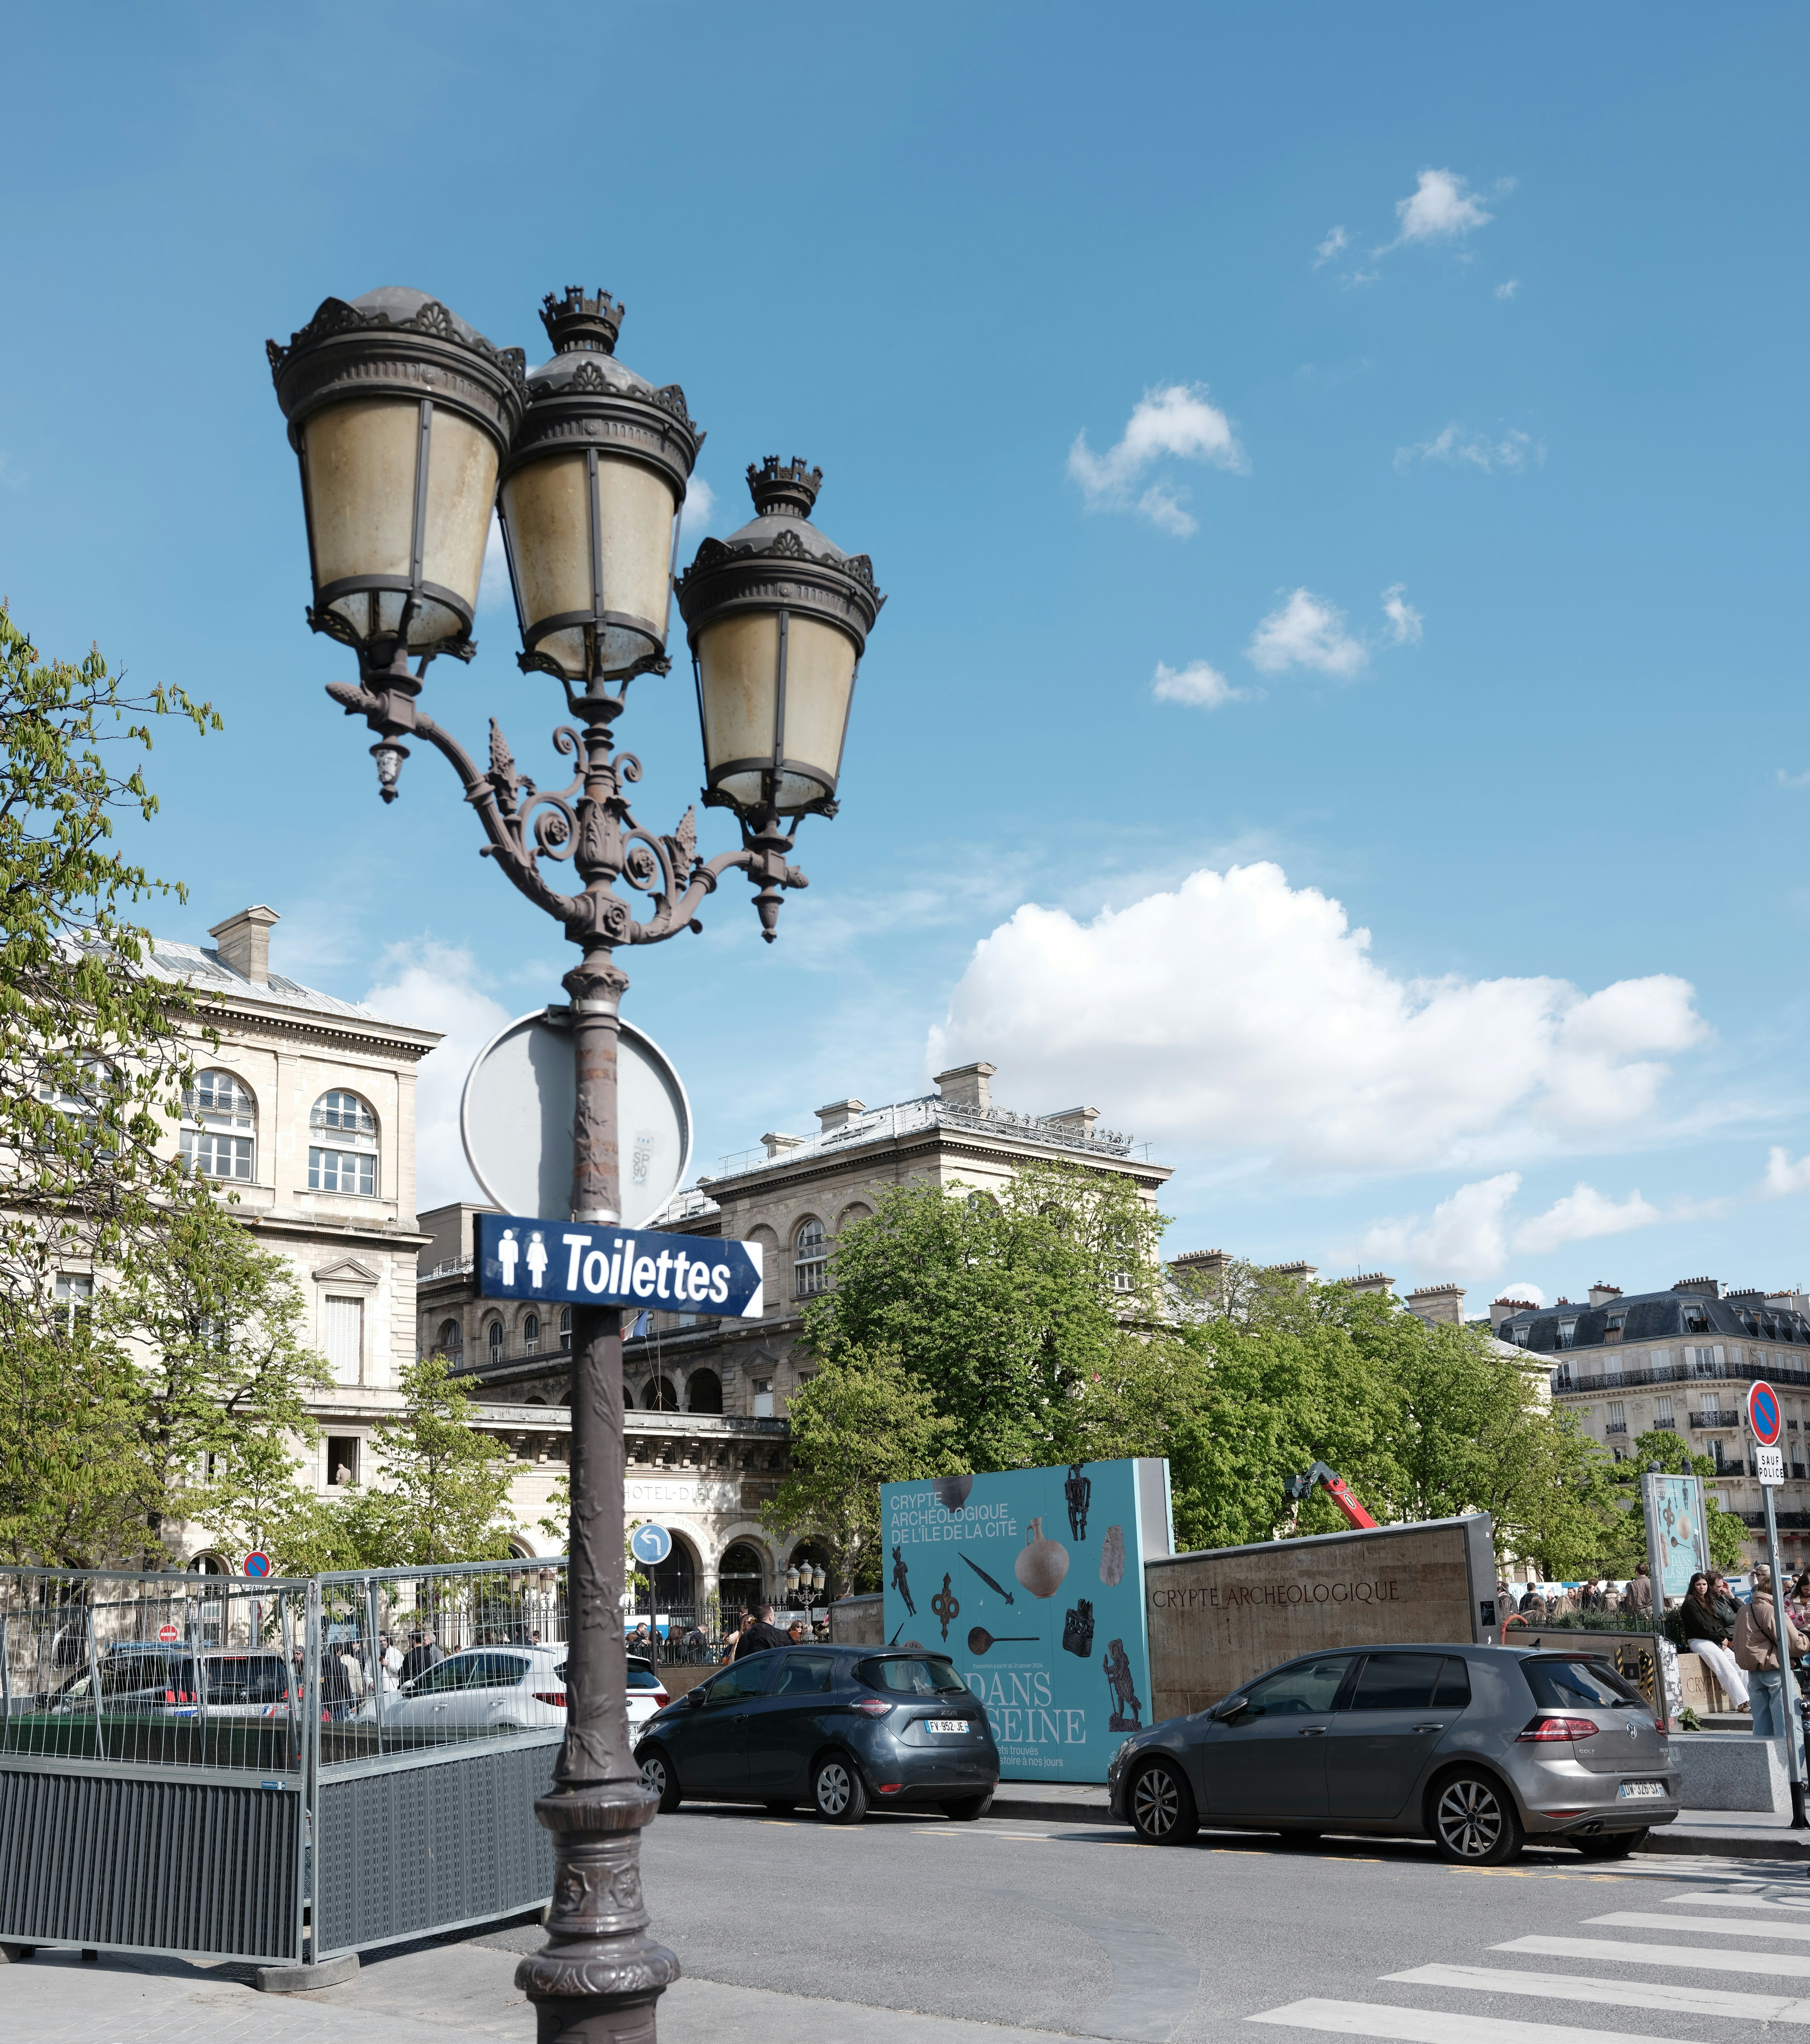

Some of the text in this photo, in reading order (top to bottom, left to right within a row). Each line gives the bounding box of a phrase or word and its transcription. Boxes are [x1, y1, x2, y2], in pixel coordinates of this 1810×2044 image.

[562, 1233, 731, 1303] Toilettes
[1762, 1456, 1779, 1466] SAUF
[1759, 1467, 1784, 1478] POLICE
[891, 1492, 942, 1510] CRYPTE
[891, 1503, 1008, 1527] ARCHÉOLOGIQUE
[892, 1529, 909, 1544] DE
[944, 1525, 962, 1540] DE
[966, 1523, 983, 1539] LA
[986, 1518, 1017, 1538] CITÉ
[1671, 1555, 1692, 1566] DANS
[1665, 1567, 1675, 1578] LA
[1153, 1581, 1400, 1608] CRYPTE ARCHEOLOGIQUE
[964, 1671, 1052, 1707] DANS
[207, 1707, 261, 1716] POLICE
[988, 1708, 1086, 1743] SEINE
[997, 1745, 1038, 1755] ets trouvés
[1000, 1756, 1021, 1765] stoire
[1022, 1756, 1027, 1765] à
[1043, 1757, 1063, 1767] jours
